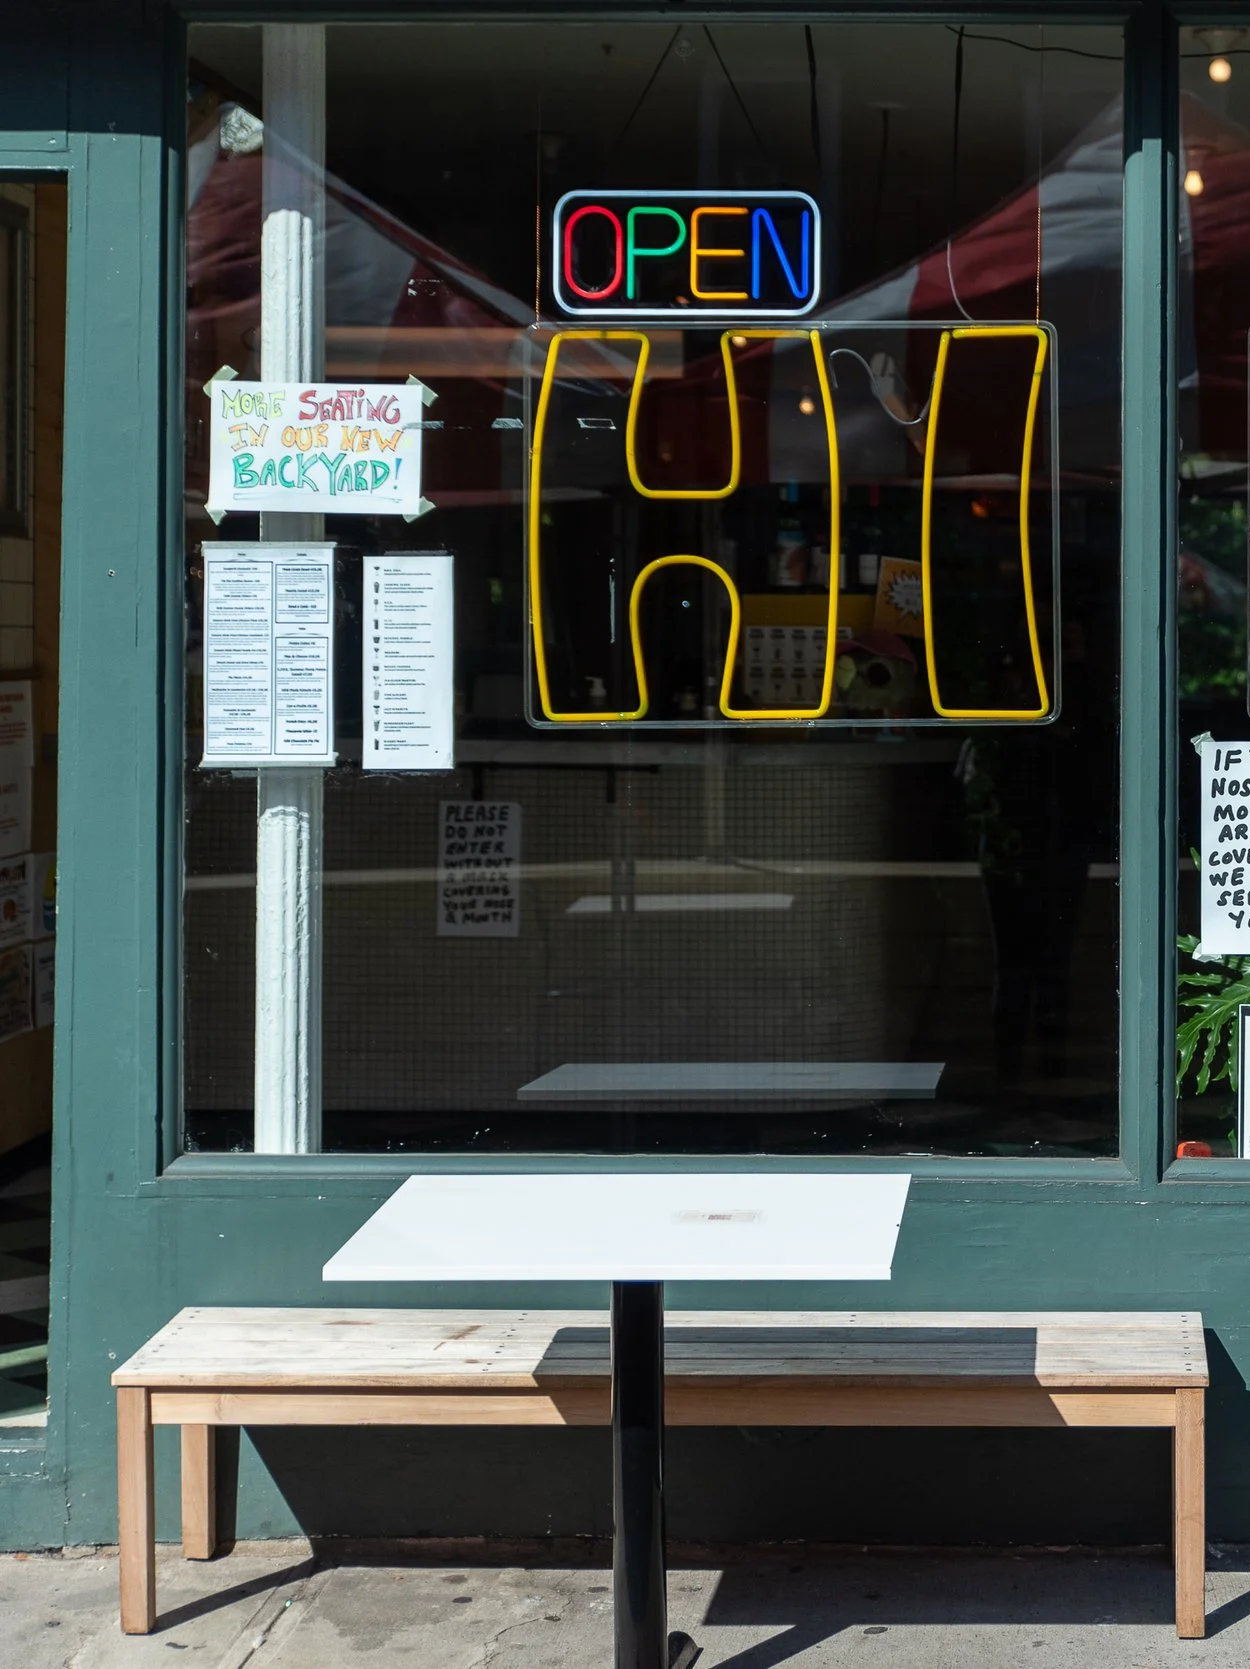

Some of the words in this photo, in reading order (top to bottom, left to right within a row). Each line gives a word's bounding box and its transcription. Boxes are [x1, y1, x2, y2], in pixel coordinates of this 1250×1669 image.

[564, 206, 811, 300] OPEN
[221, 388, 286, 420] MORE
[228, 422, 269, 452] IN
[281, 423, 330, 452] OUR
[339, 425, 404, 453] NEW
[1213, 748, 1243, 771] IF
[445, 804, 511, 823] PLEASE
[444, 825, 468, 839] DO
[474, 824, 509, 838] NOT
[445, 841, 505, 855] ENTER
[444, 857, 514, 870] WITHOUT
[1209, 867, 1245, 887] WE
[442, 886, 511, 898] COVERING
[443, 898, 478, 911] YOUR
[484, 898, 515, 909] NOSE
[445, 910, 456, 924] &
[462, 910, 513, 924] MOUTH
